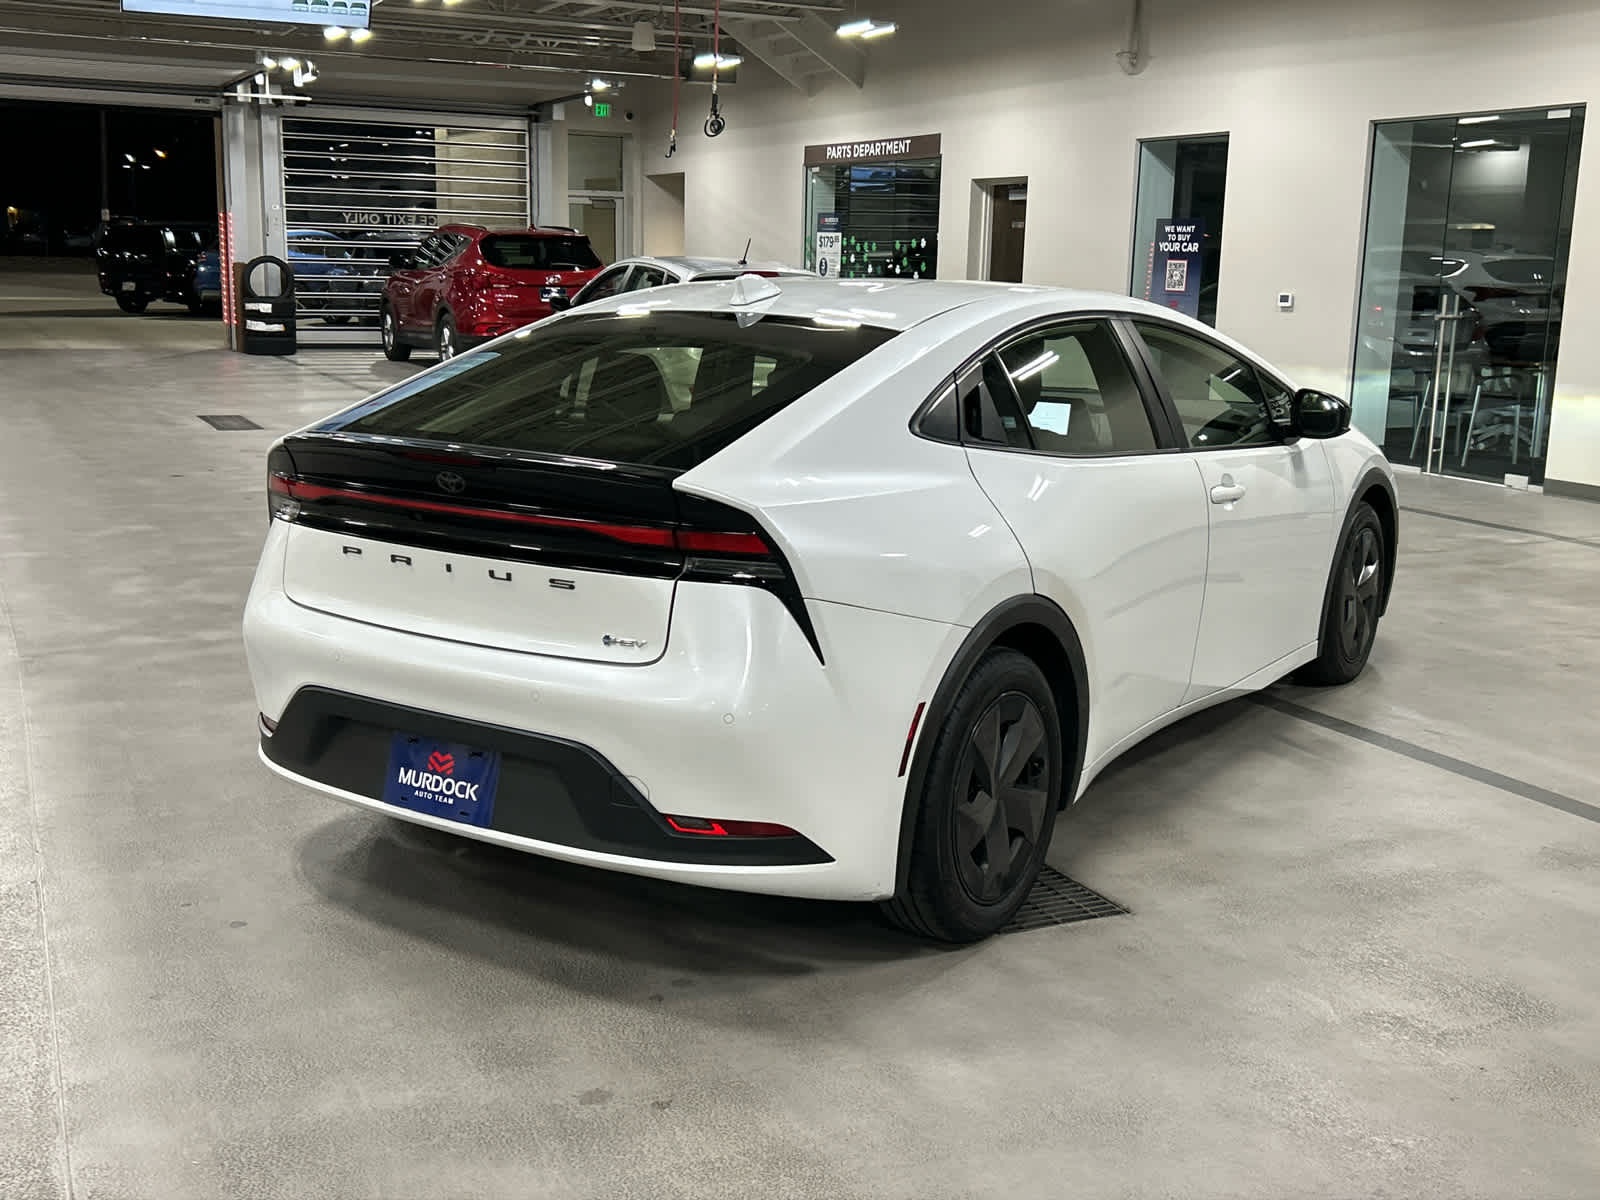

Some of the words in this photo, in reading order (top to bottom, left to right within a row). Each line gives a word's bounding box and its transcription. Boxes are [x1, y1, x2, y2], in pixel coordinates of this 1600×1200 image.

[826, 145, 852, 160] PARTS
[853, 139, 911, 158] DEPARTMENT
[1164, 225, 1175, 233] WE
[1176, 225, 1196, 233] WANT
[1159, 242, 1180, 252] YOUR
[1181, 242, 1199, 252] CAR
[343, 545, 575, 590] PRIUS
[398, 767, 479, 801] MURDOCK
[414, 790, 433, 800] AUTO
[435, 795, 454, 804] TEAM
